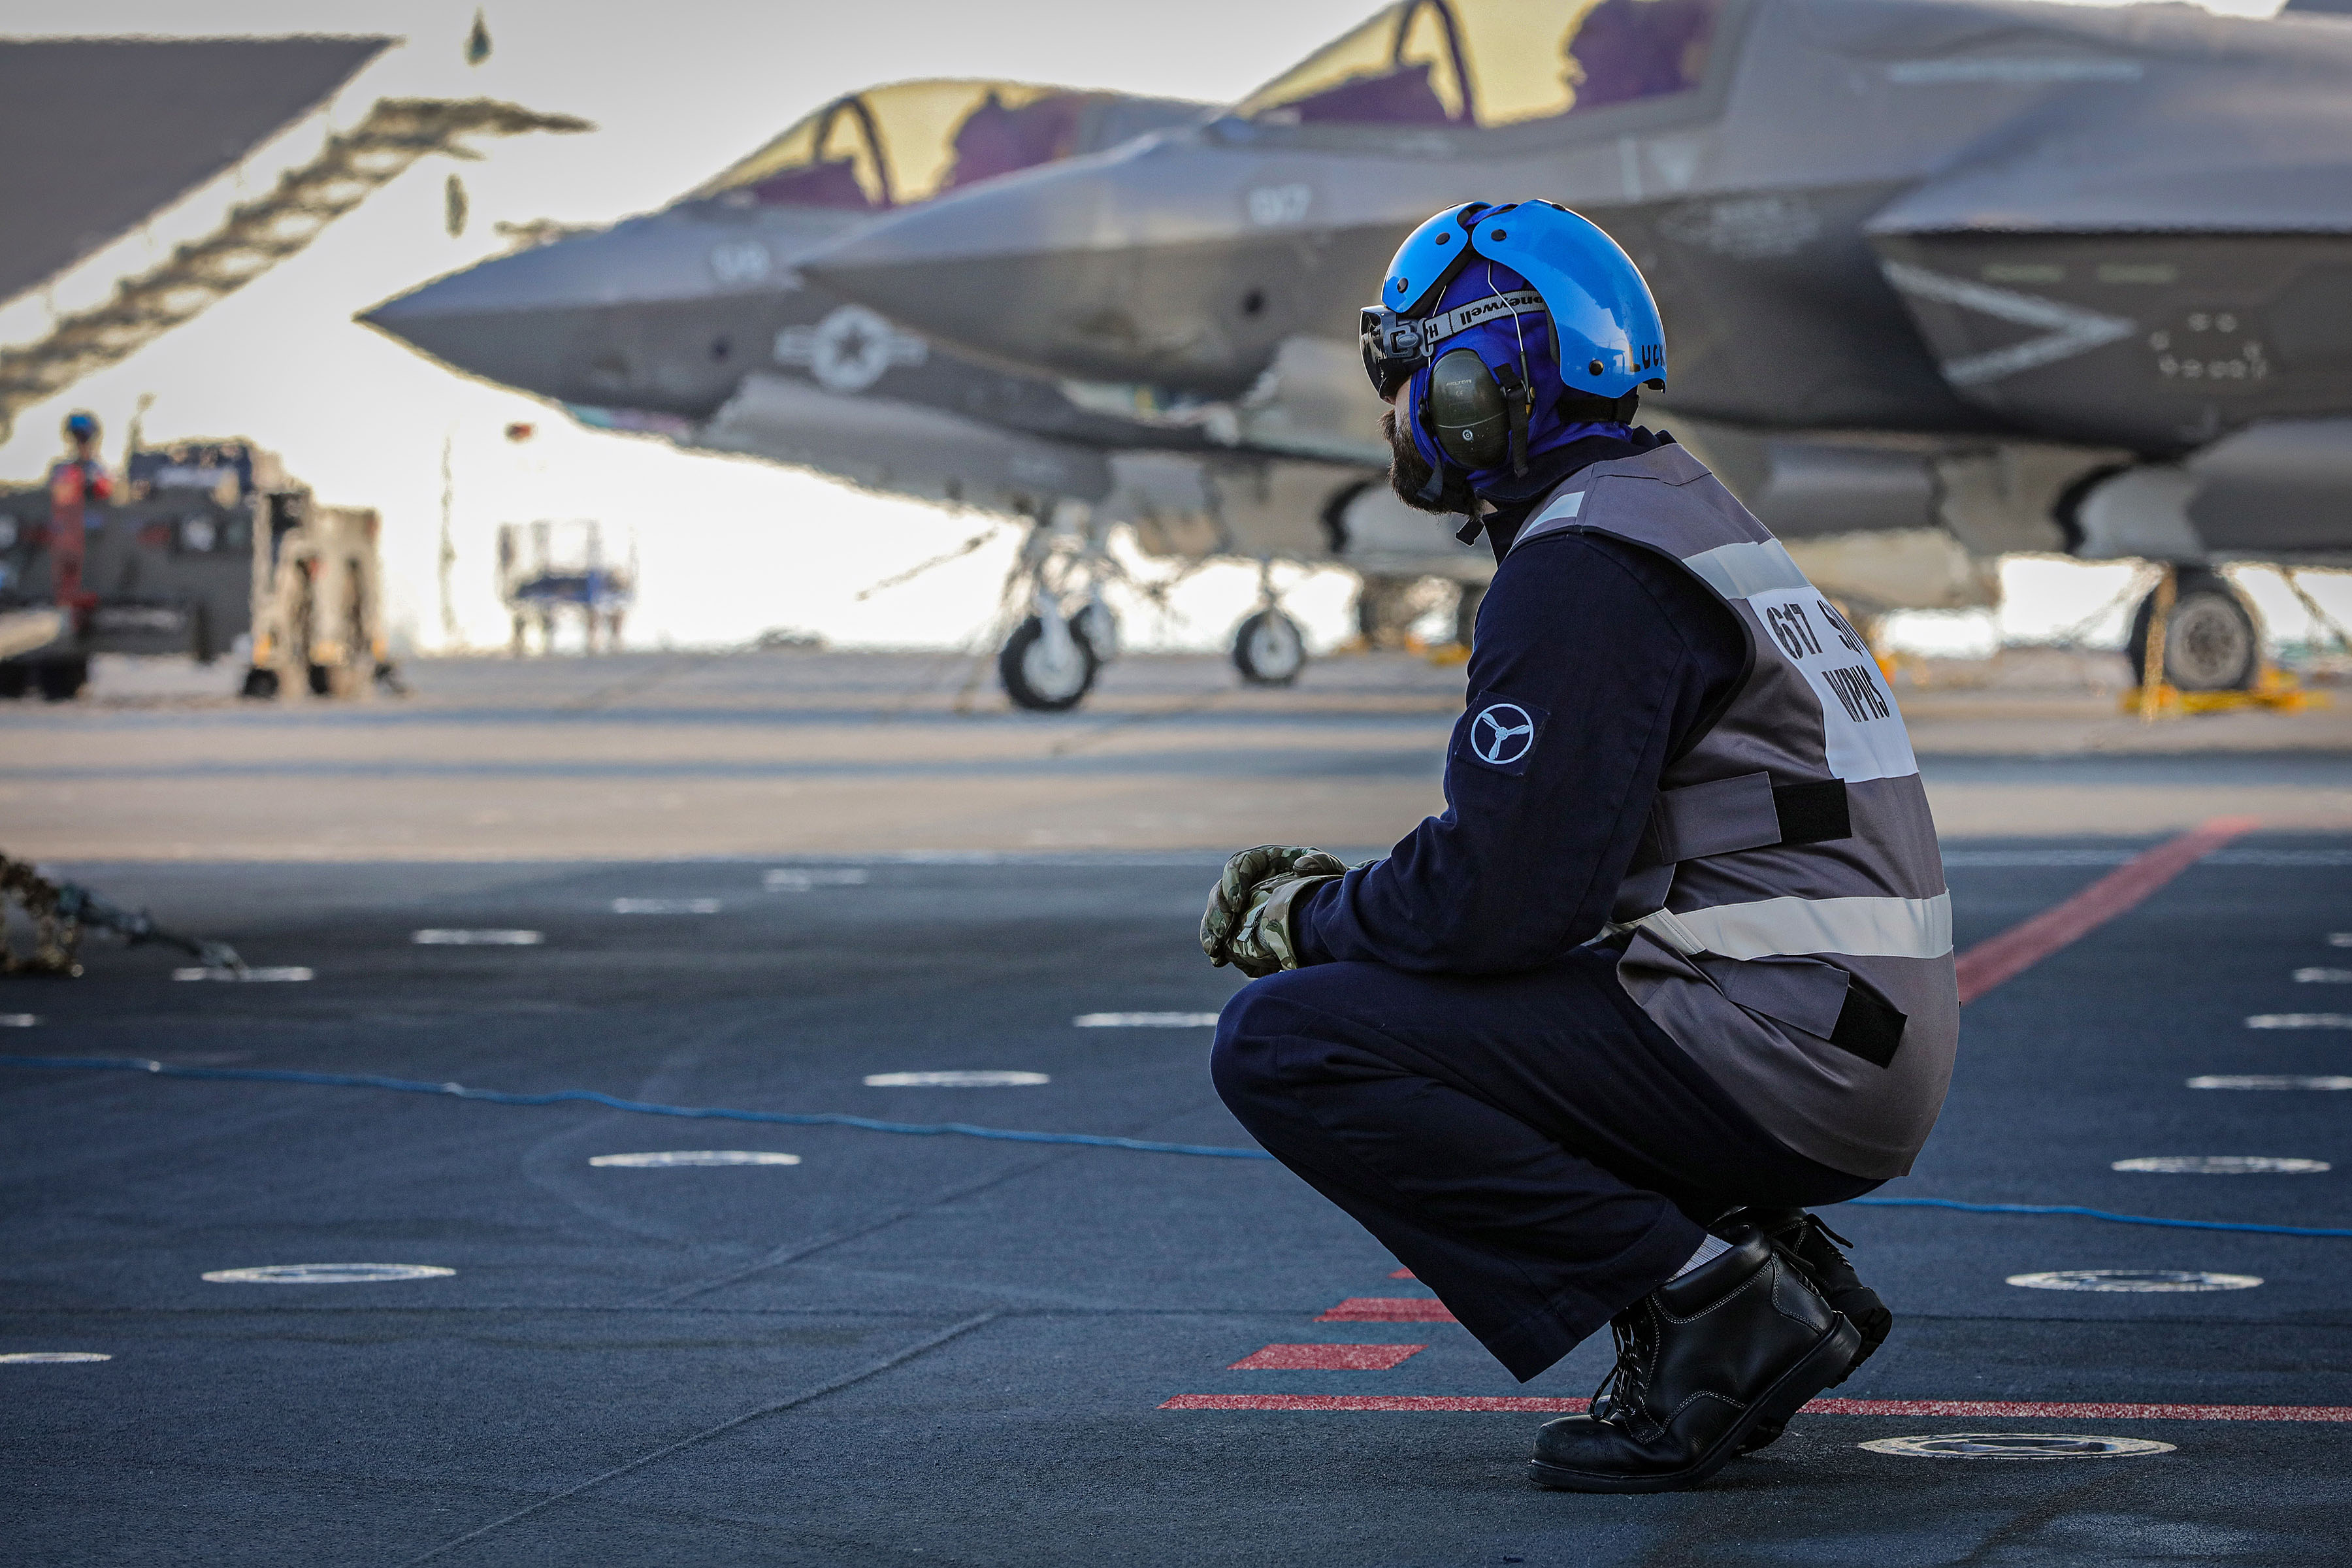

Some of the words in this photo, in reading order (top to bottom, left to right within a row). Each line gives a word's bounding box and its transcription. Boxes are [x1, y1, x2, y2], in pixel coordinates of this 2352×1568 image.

[1460, 296, 1544, 325] oneywell
[1767, 603, 1823, 659] 617
[1821, 665, 1890, 723] WPNS
